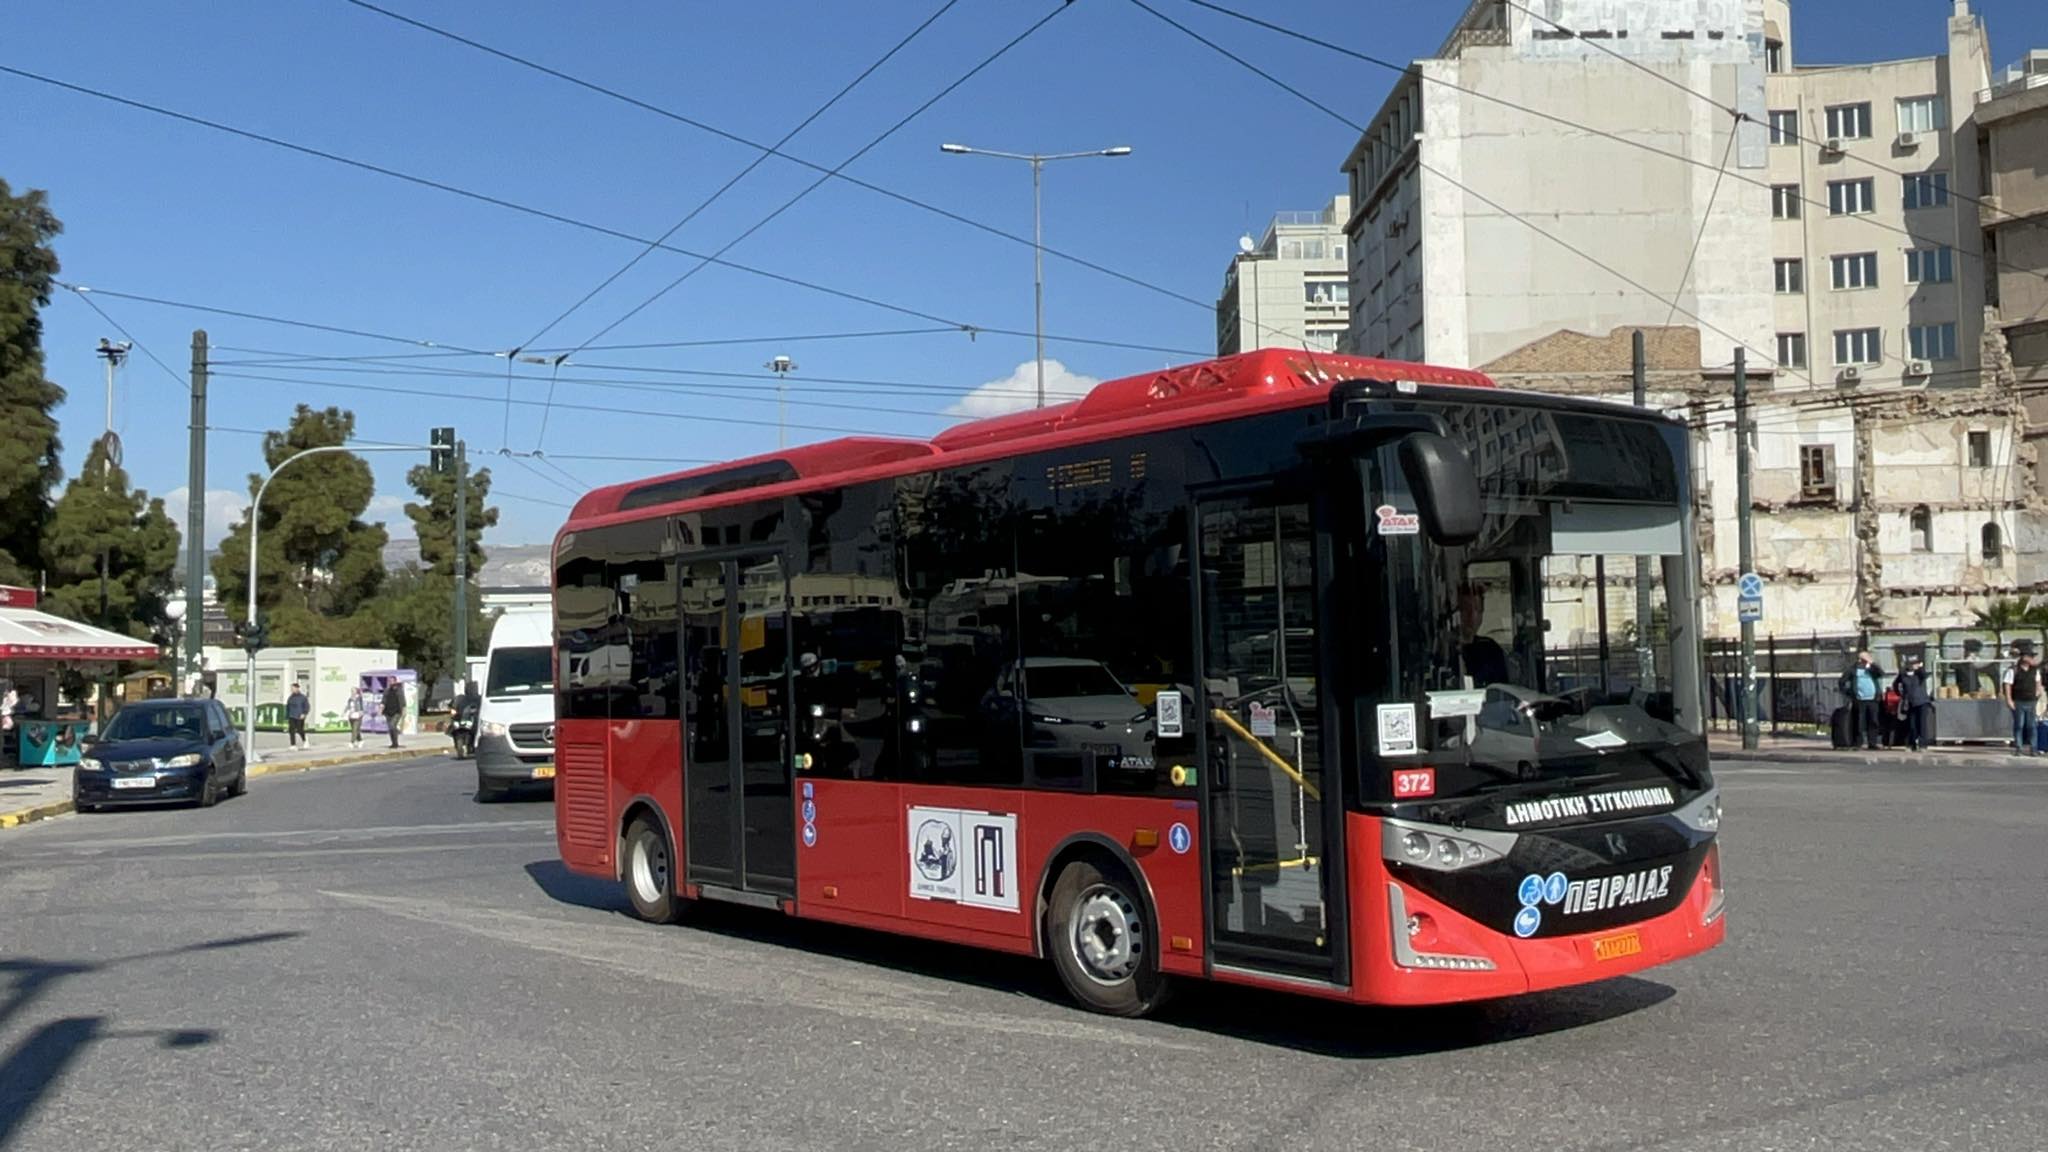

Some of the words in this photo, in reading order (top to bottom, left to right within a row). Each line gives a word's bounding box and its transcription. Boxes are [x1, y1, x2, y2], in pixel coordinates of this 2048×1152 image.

[1398, 773, 1431, 793] 372
[1505, 795, 1588, 825] ΔΗΜΟΤΙΚΗ
[1588, 787, 1674, 814] ΣΥΓΚΟΙΝΩΝΙΑ
[1563, 865, 1673, 914] ΠΕΙΡΑΙΑΣ
